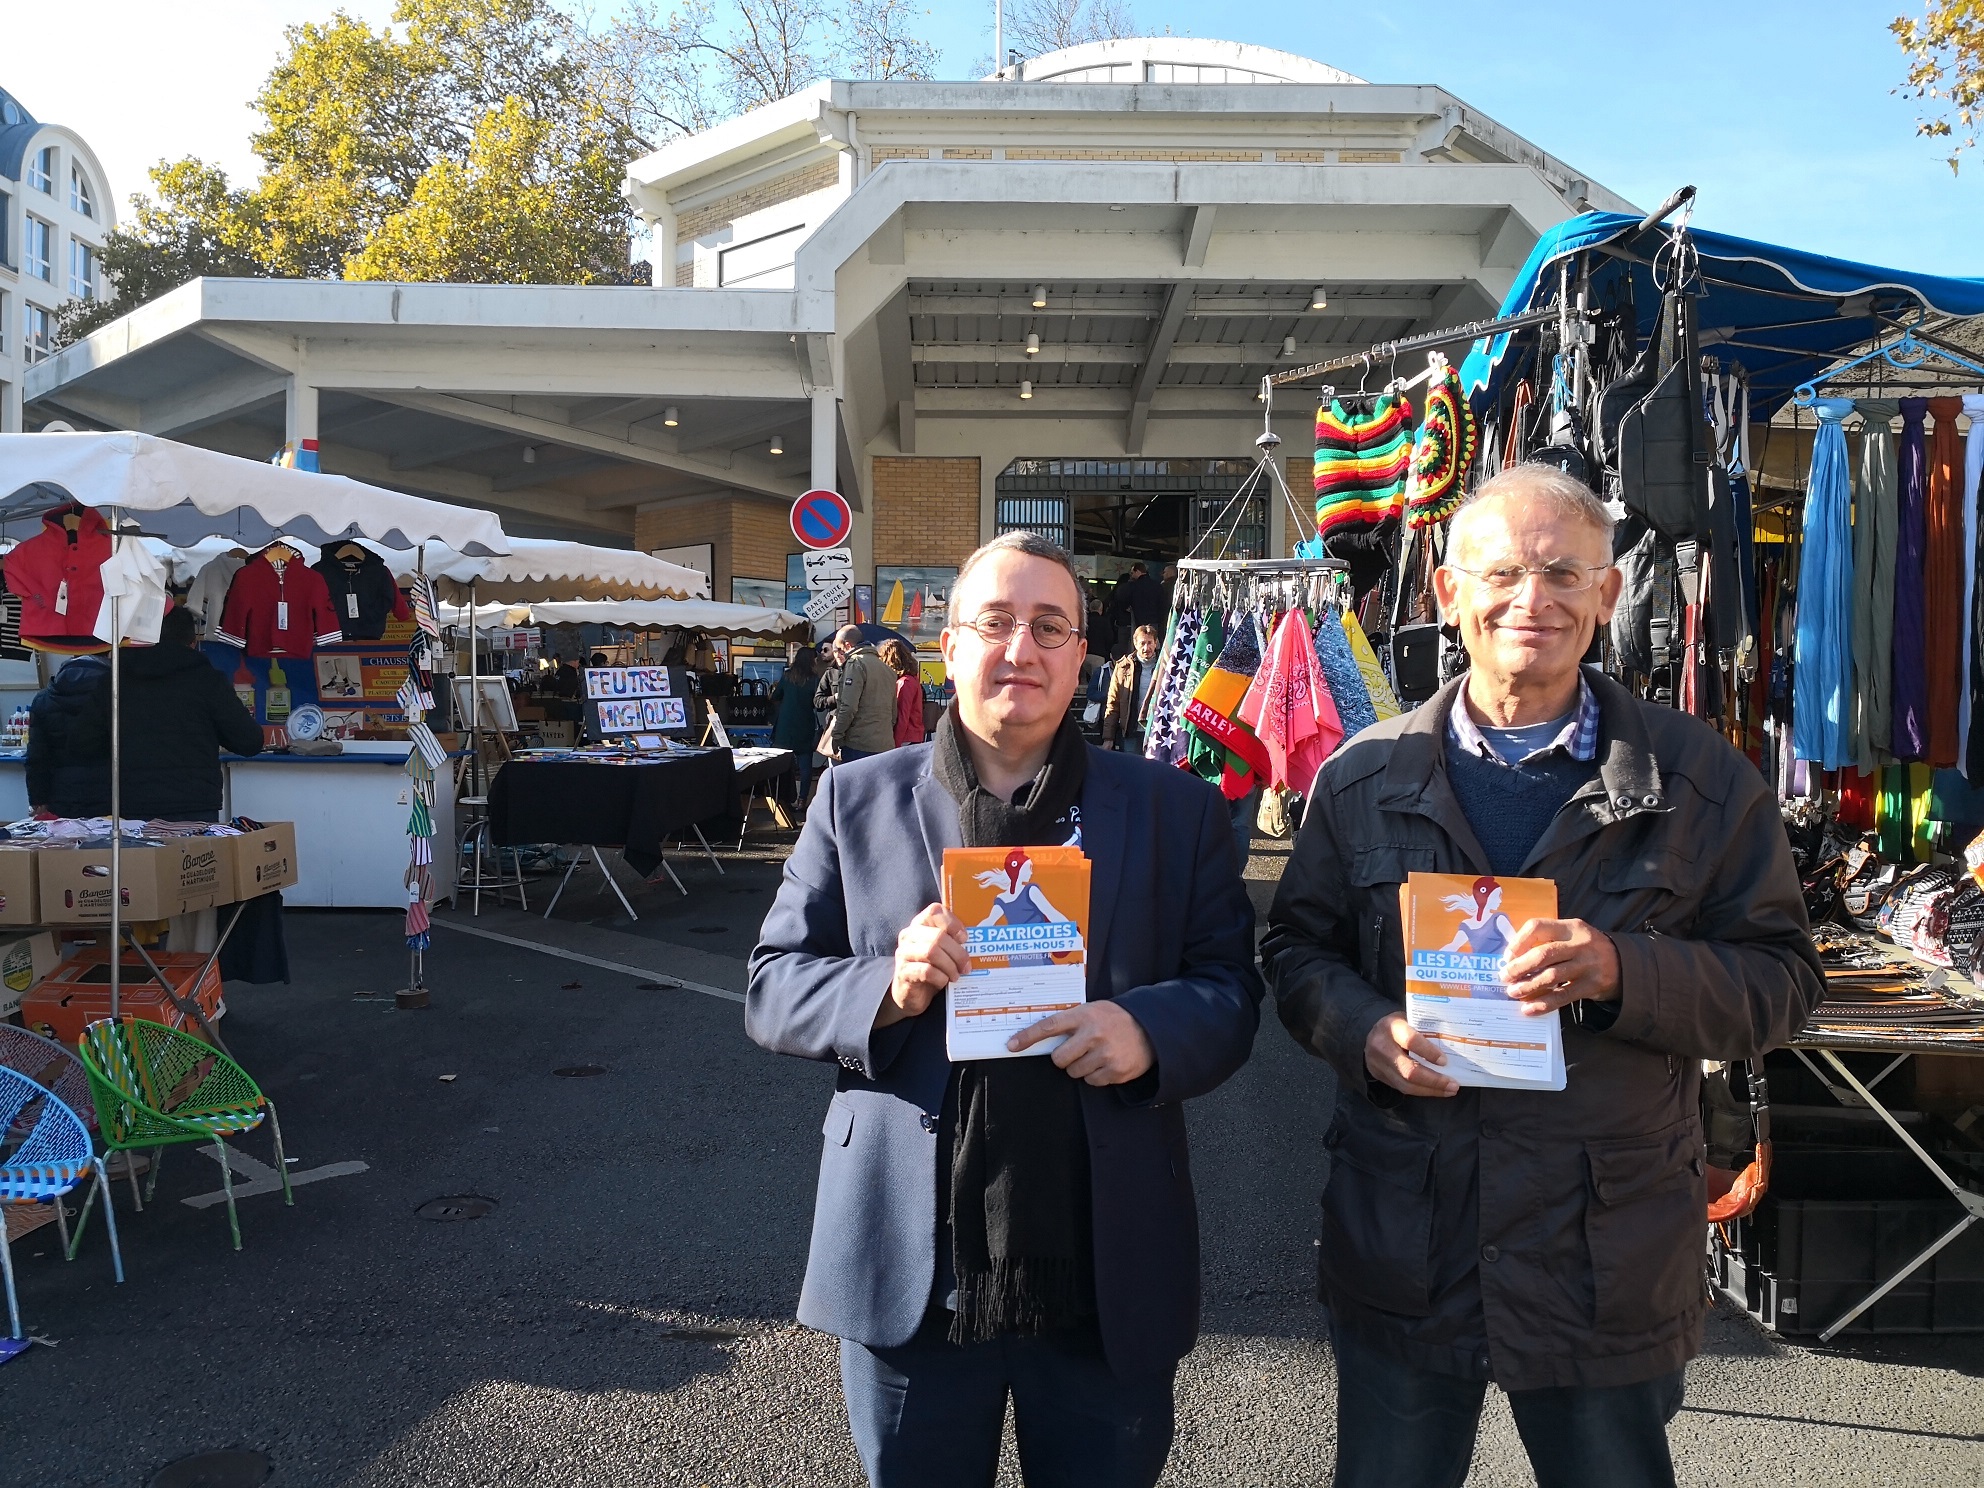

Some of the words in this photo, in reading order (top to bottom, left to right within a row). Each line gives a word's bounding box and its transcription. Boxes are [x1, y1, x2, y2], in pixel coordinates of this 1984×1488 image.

[806, 598, 823, 613] DANS
[823, 583, 842, 600] TOUTE
[811, 602, 830, 619] CETTE
[829, 590, 847, 605] ZONE
[588, 669, 669, 696] FEUTRES
[182, 850, 218, 871] Banane
[186, 866, 216, 879] GUADELOUPE
[186, 874, 215, 885] MARTINIQUE
[965, 928, 985, 942] ES
[988, 924, 1072, 941] PATRIOTES
[964, 945, 977, 954] UI
[980, 940, 1065, 953] SOMMES-NOUS
[1068, 939, 1075, 948] ?
[979, 952, 1052, 963] WWW.LES-PATRIOTES.FR
[1417, 953, 1445, 967] LES
[1449, 955, 1507, 971] PATRIO
[1416, 969, 1437, 979] QUI
[1441, 971, 1502, 982] SOMMES-
[2, 999, 19, 1012] BAN
